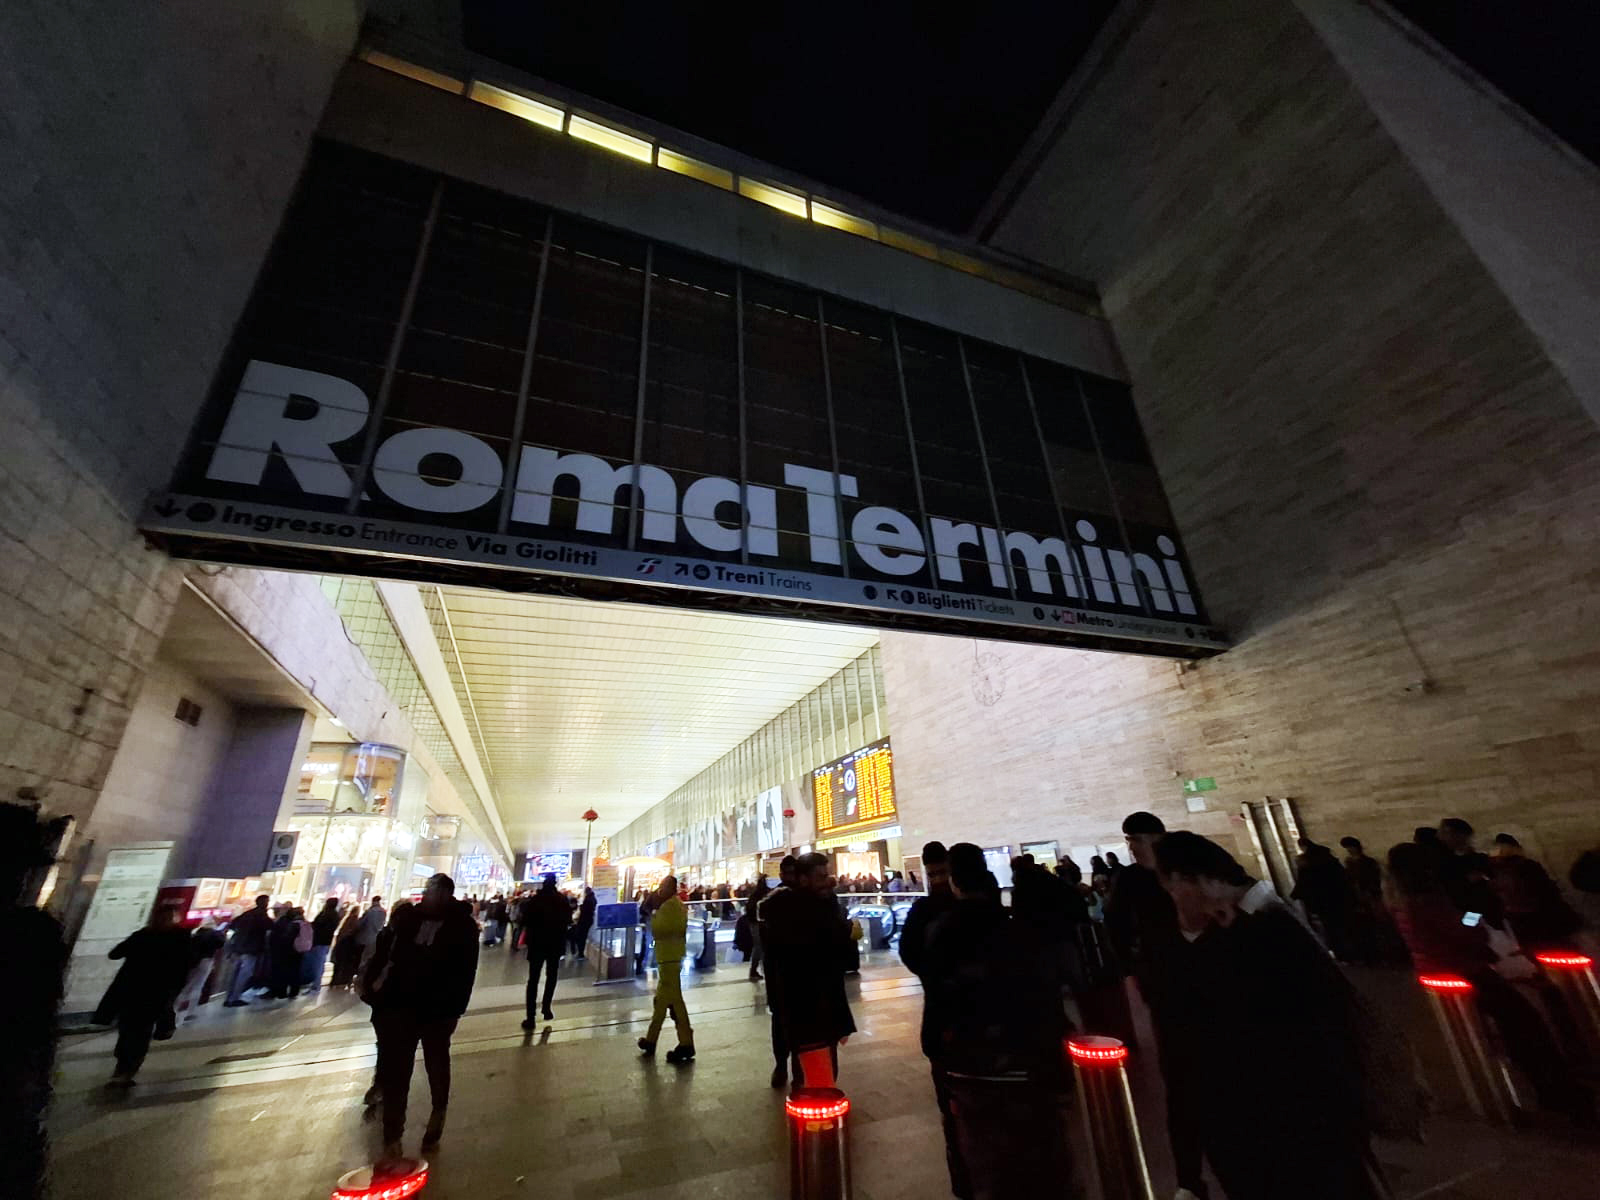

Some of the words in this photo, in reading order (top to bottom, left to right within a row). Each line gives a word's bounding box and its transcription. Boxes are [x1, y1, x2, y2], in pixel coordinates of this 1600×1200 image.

[221, 505, 356, 538] Ingresso
[360, 523, 458, 550] Entrance
[465, 535, 507, 555] Via
[516, 542, 597, 566] Giolitti
[714, 566, 765, 586] Treni
[768, 572, 812, 591] Trains
[917, 591, 976, 611] Biglietti
[1076, 611, 1114, 628] Metro
